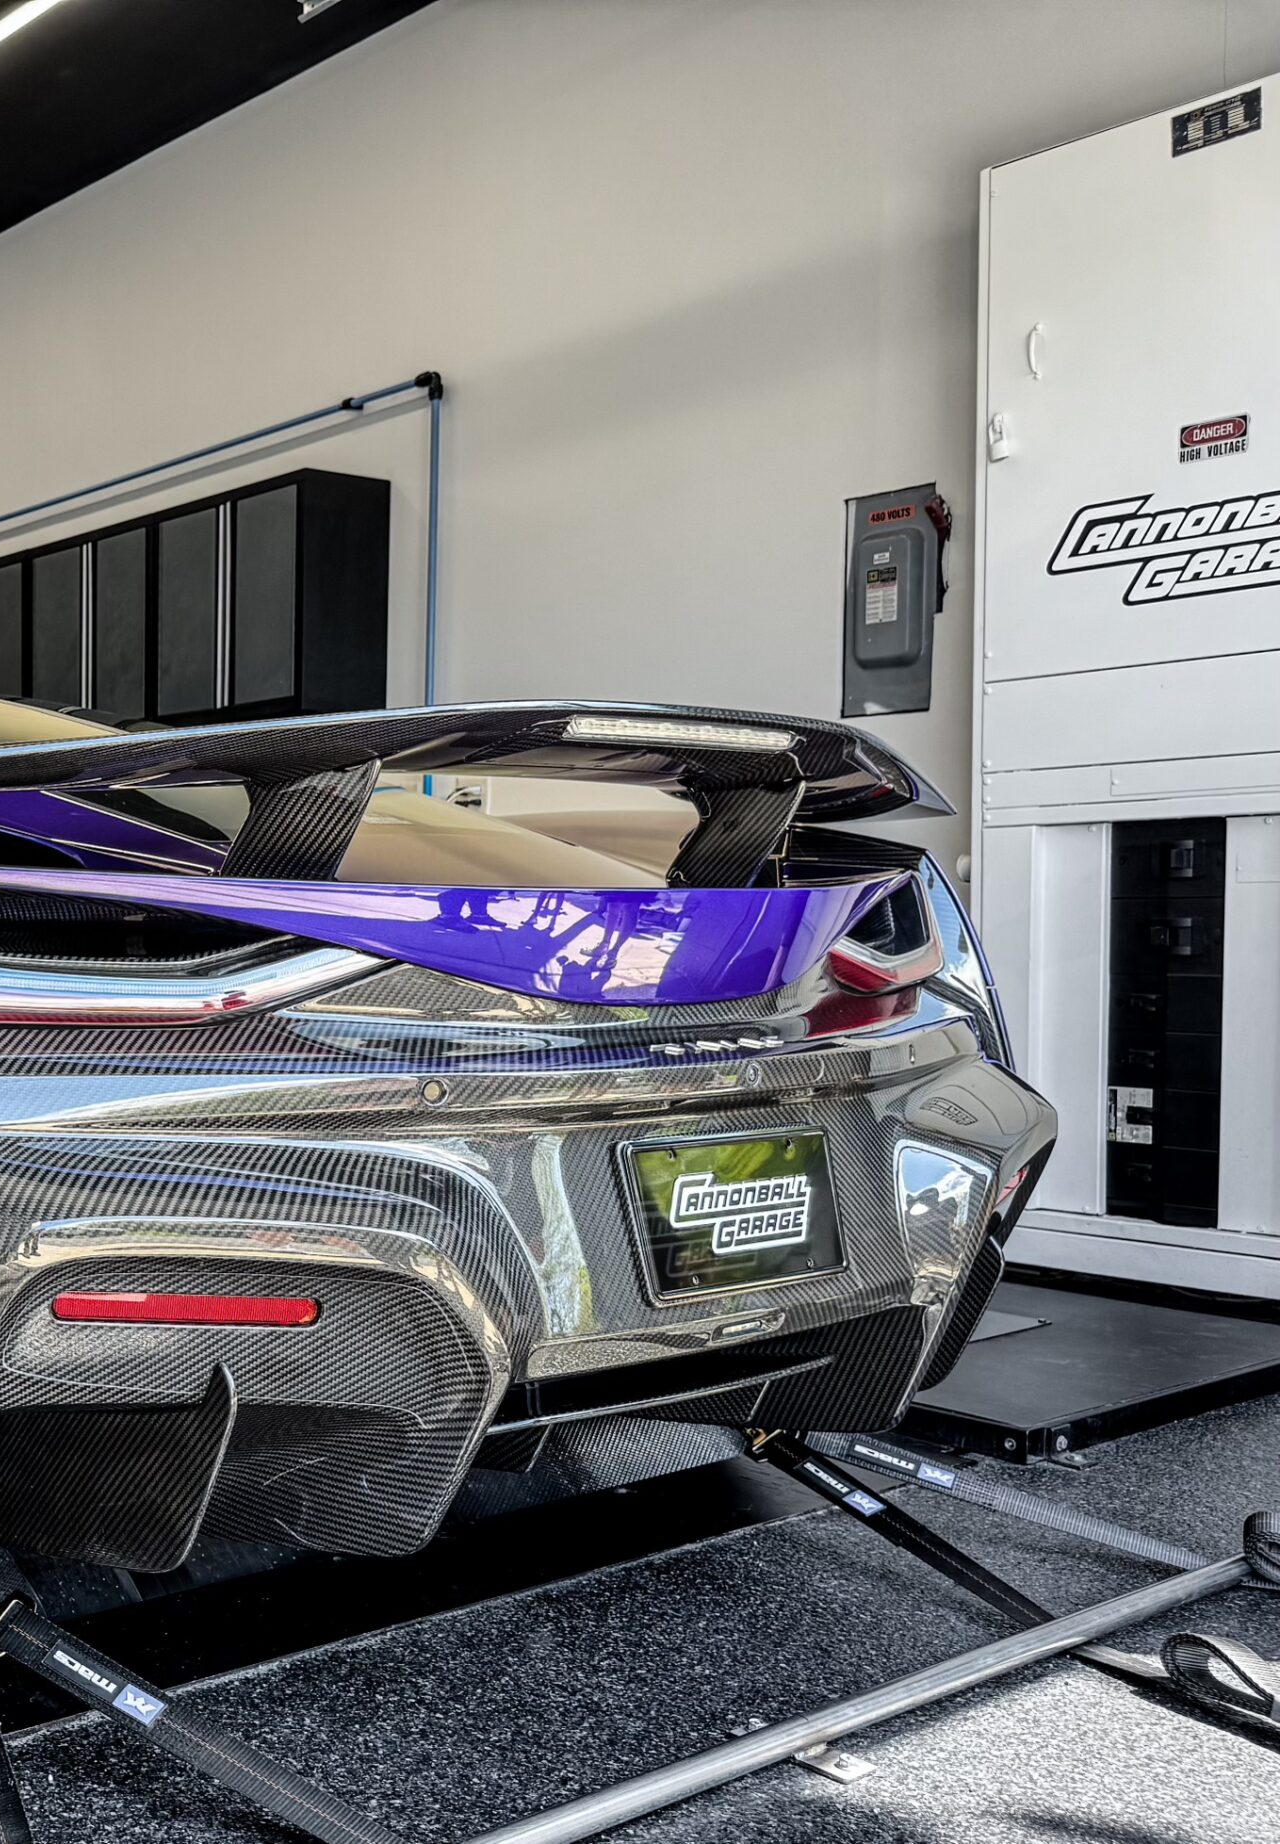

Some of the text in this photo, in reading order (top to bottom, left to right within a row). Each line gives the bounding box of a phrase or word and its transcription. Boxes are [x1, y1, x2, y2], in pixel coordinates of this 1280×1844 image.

[1192, 422, 1234, 442] DANGER
[1179, 438, 1247, 463] HIGH VOLTAGE
[887, 506, 911, 520] VOLTS
[1047, 489, 1280, 575] CANNONB
[714, 1209, 807, 1252] GARAGE
